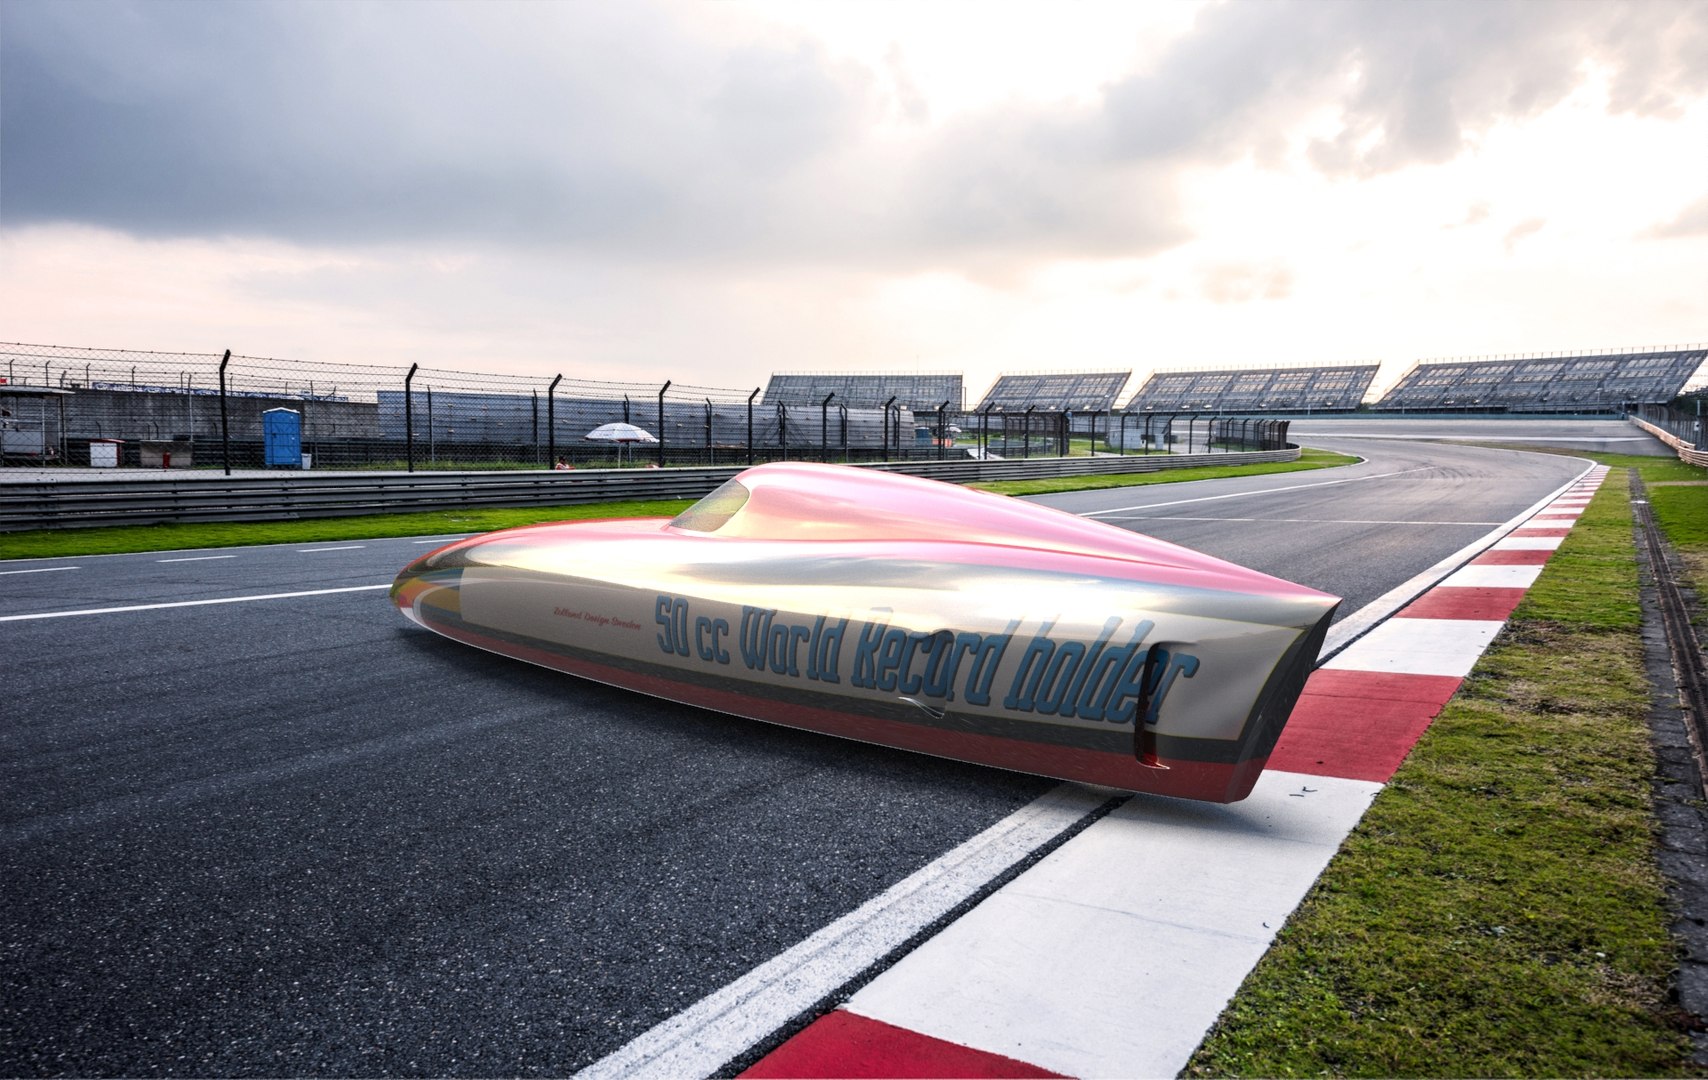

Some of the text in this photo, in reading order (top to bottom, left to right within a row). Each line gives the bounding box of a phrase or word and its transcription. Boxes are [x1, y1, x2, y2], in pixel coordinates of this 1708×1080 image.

[584, 611, 610, 627] Design
[611, 616, 642, 631] Sweden
[655, 594, 1200, 725] 50 cc World Record holder
